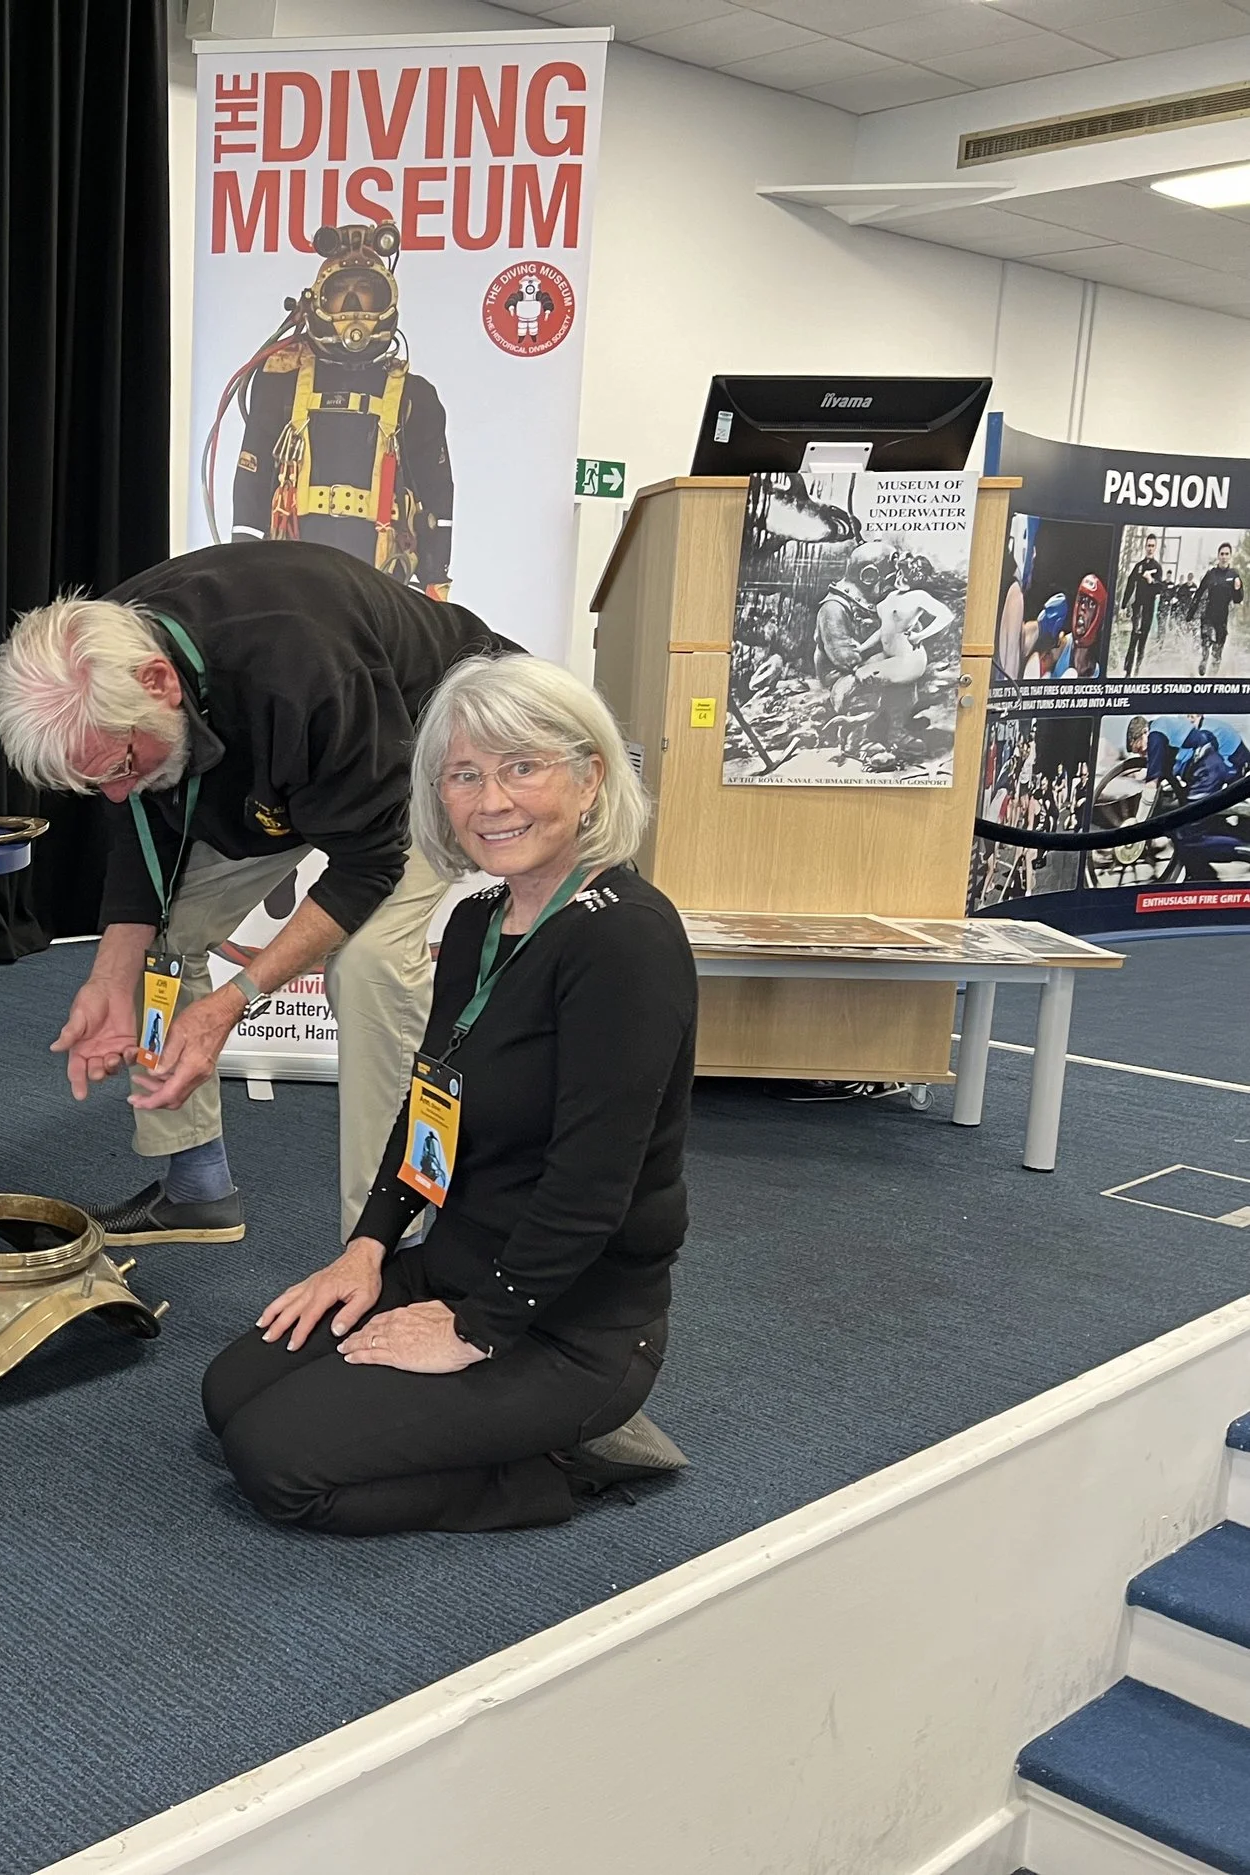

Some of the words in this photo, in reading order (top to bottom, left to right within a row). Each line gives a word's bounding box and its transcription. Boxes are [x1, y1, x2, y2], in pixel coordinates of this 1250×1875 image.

[214, 73, 258, 164] THE
[262, 62, 587, 162] DIVING
[211, 164, 582, 254] MUSEUM
[486, 283, 502, 305] THE
[500, 264, 537, 284] DIVING
[540, 265, 572, 307] MUSEUM
[491, 329, 527, 353] HISTORICAL
[529, 341, 553, 353] DIVING
[552, 315, 571, 343] SOCIETY
[820, 392, 873, 408] iiyama
[877, 480, 939, 490] MUSEUM
[944, 480, 964, 490] OF
[1104, 470, 1230, 509] PASSION
[876, 495, 927, 504] DIVING
[930, 494, 961, 504] AND
[869, 508, 966, 518] UNDERWATER
[866, 522, 967, 531] EXPLORATION
[1060, 685, 1074, 695] OUR
[1105, 684, 1123, 694] THAT
[1123, 684, 1150, 694] MAKES
[1151, 684, 1163, 694] US
[1163, 684, 1192, 694] STAND
[1193, 684, 1212, 694] OUT
[1213, 684, 1240, 694] FROM
[1088, 698, 1105, 708] INTO
[1106, 698, 1113, 707] A
[1113, 698, 1130, 707] LIFE.
[1142, 895, 1197, 908] ENTHUSIASM
[1198, 894, 1219, 904] FIRE
[1219, 893, 1242, 904] GRIT
[276, 1000, 334, 1020] Battery,
[237, 1022, 300, 1042] Gosport,
